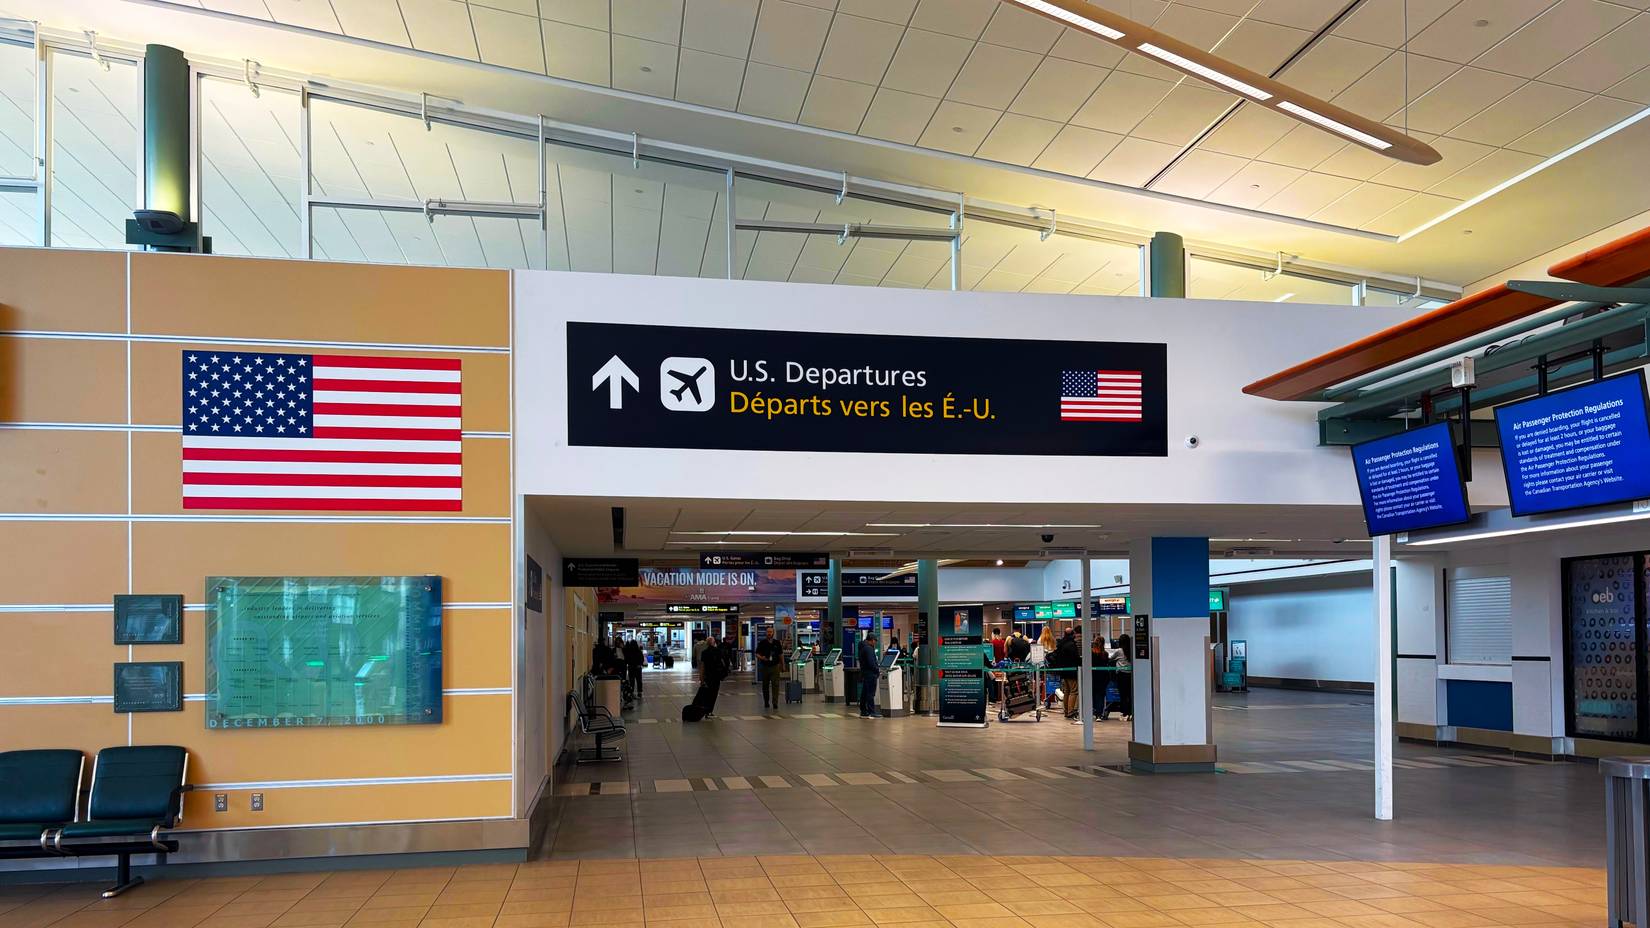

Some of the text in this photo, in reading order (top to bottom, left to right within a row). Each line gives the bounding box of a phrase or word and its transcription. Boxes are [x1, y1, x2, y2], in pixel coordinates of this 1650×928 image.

[730, 359, 928, 390] U.S. Departures
[730, 391, 996, 420] Départs vers les É.-U.
[1523, 417, 1550, 427] Passenger
[1552, 409, 1583, 420] Protection
[1585, 400, 1623, 413] Regulations
[1371, 455, 1390, 463] Passenger
[1391, 449, 1412, 458] Protection
[1413, 443, 1438, 453] Regulations
[643, 572, 757, 586] VACATION MODE IS ON.
[209, 717, 305, 728] DECEMBER
[345, 715, 385, 725] 2000
